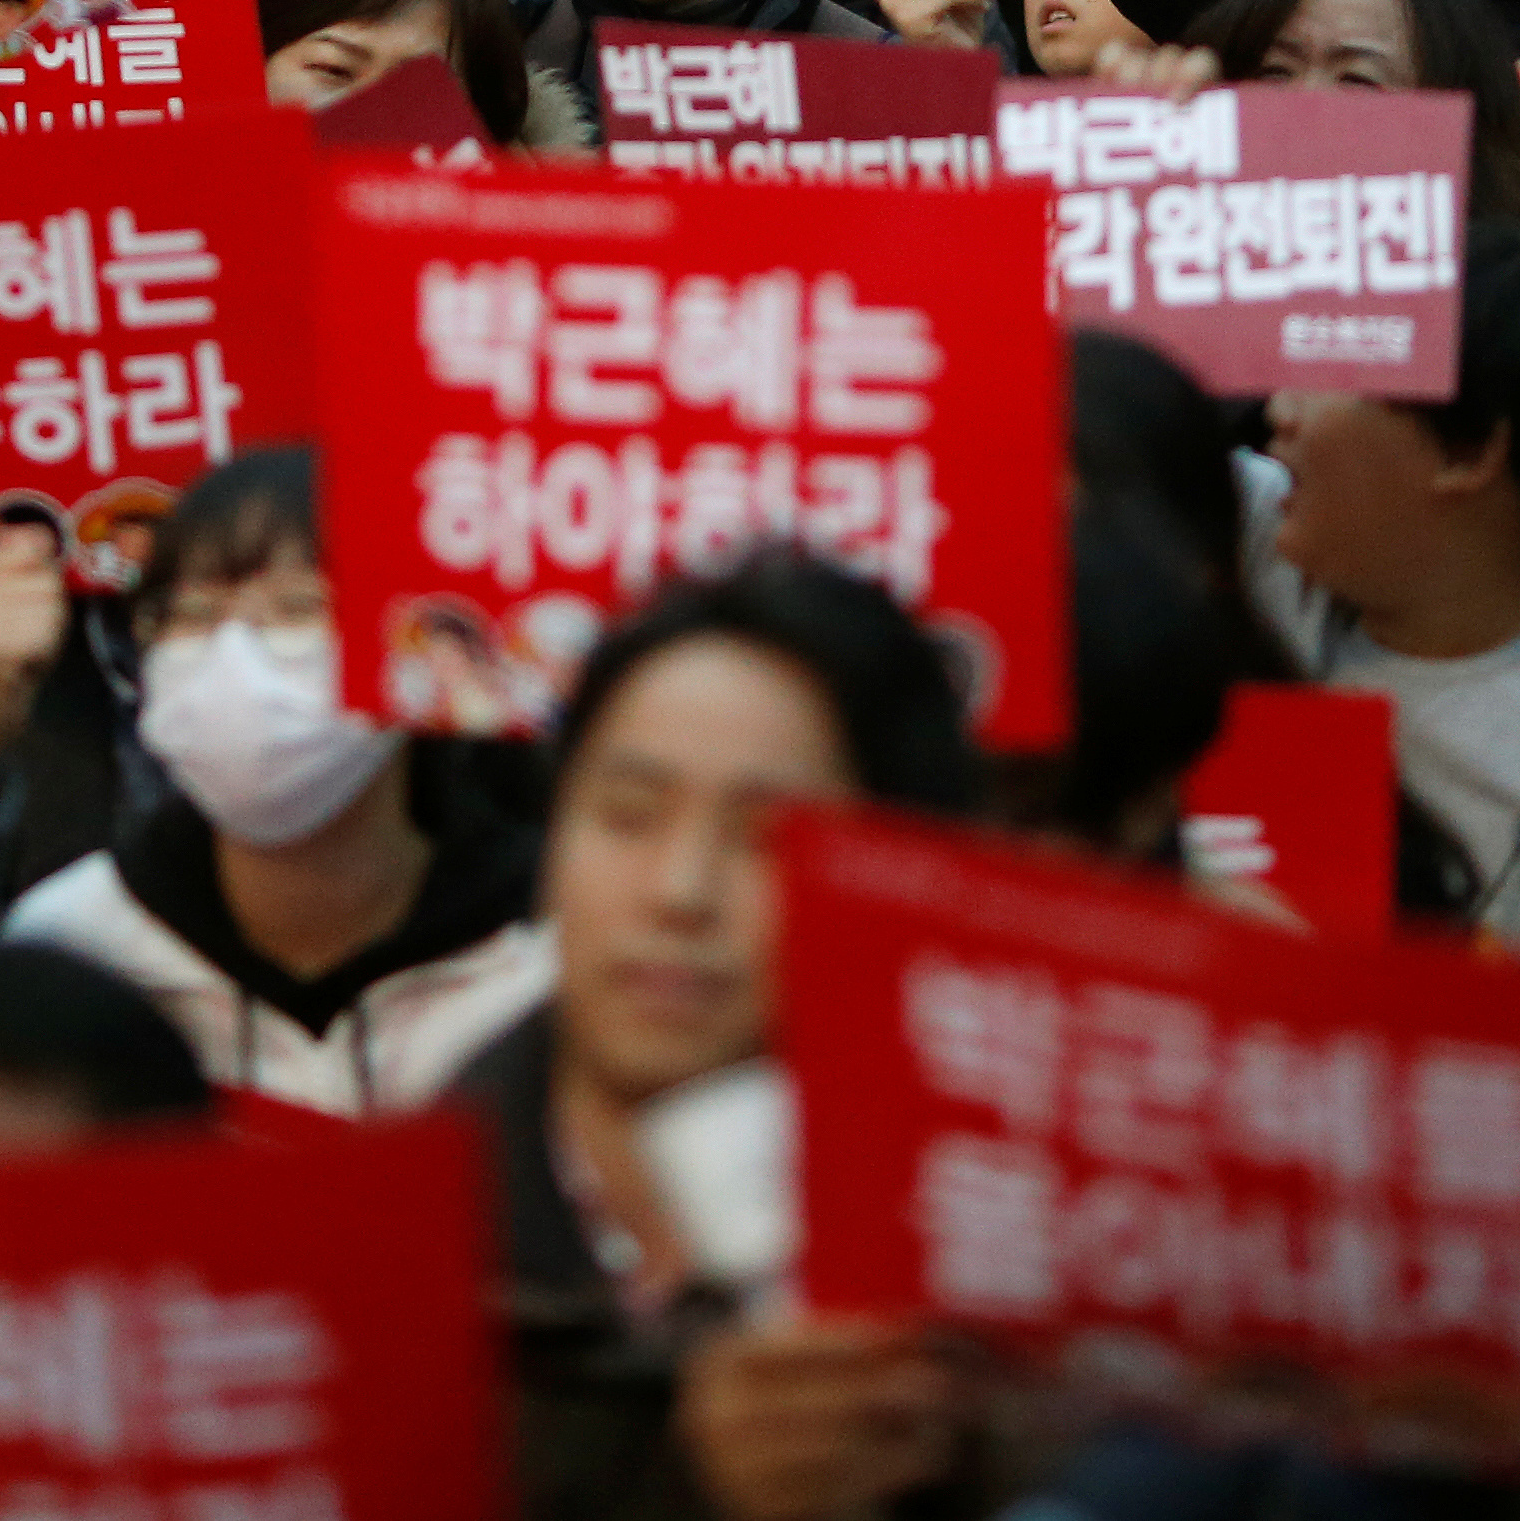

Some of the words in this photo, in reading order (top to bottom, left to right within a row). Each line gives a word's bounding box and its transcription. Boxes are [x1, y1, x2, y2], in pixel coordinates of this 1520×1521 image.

[600, 40, 804, 134] 박근혜
[996, 87, 1241, 189] 박근혜
[1145, 171, 1459, 307] 완전퇴진!
[415, 257, 945, 436] 박근혜는
